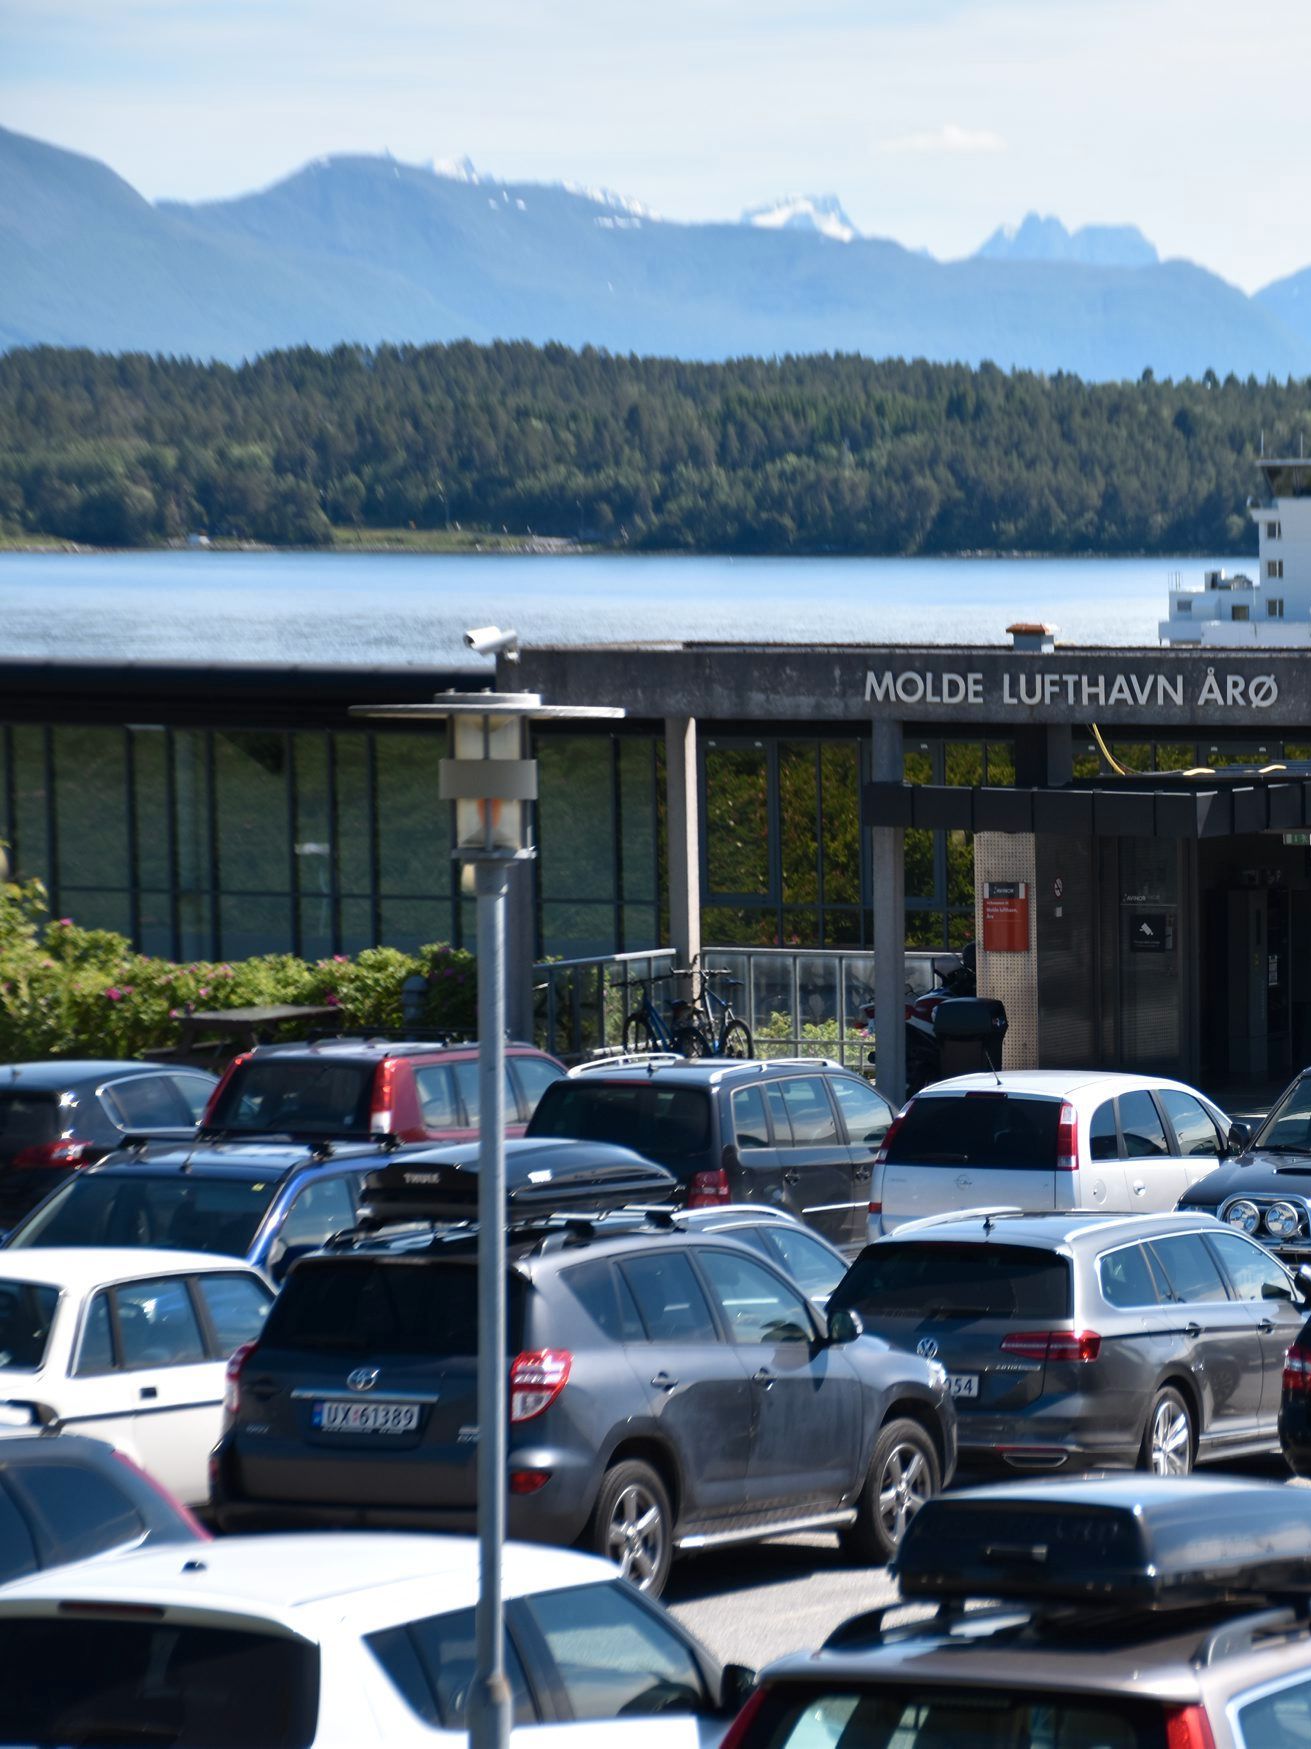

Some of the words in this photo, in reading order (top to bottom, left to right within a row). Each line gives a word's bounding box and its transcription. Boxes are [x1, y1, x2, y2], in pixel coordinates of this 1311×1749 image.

[865, 671, 984, 704] MOLDE
[1003, 673, 1183, 706] LUFTHAVN
[1197, 666, 1279, 708] ÅRØ
[327, 1403, 352, 1426] UX
[359, 1406, 413, 1428] 61389
